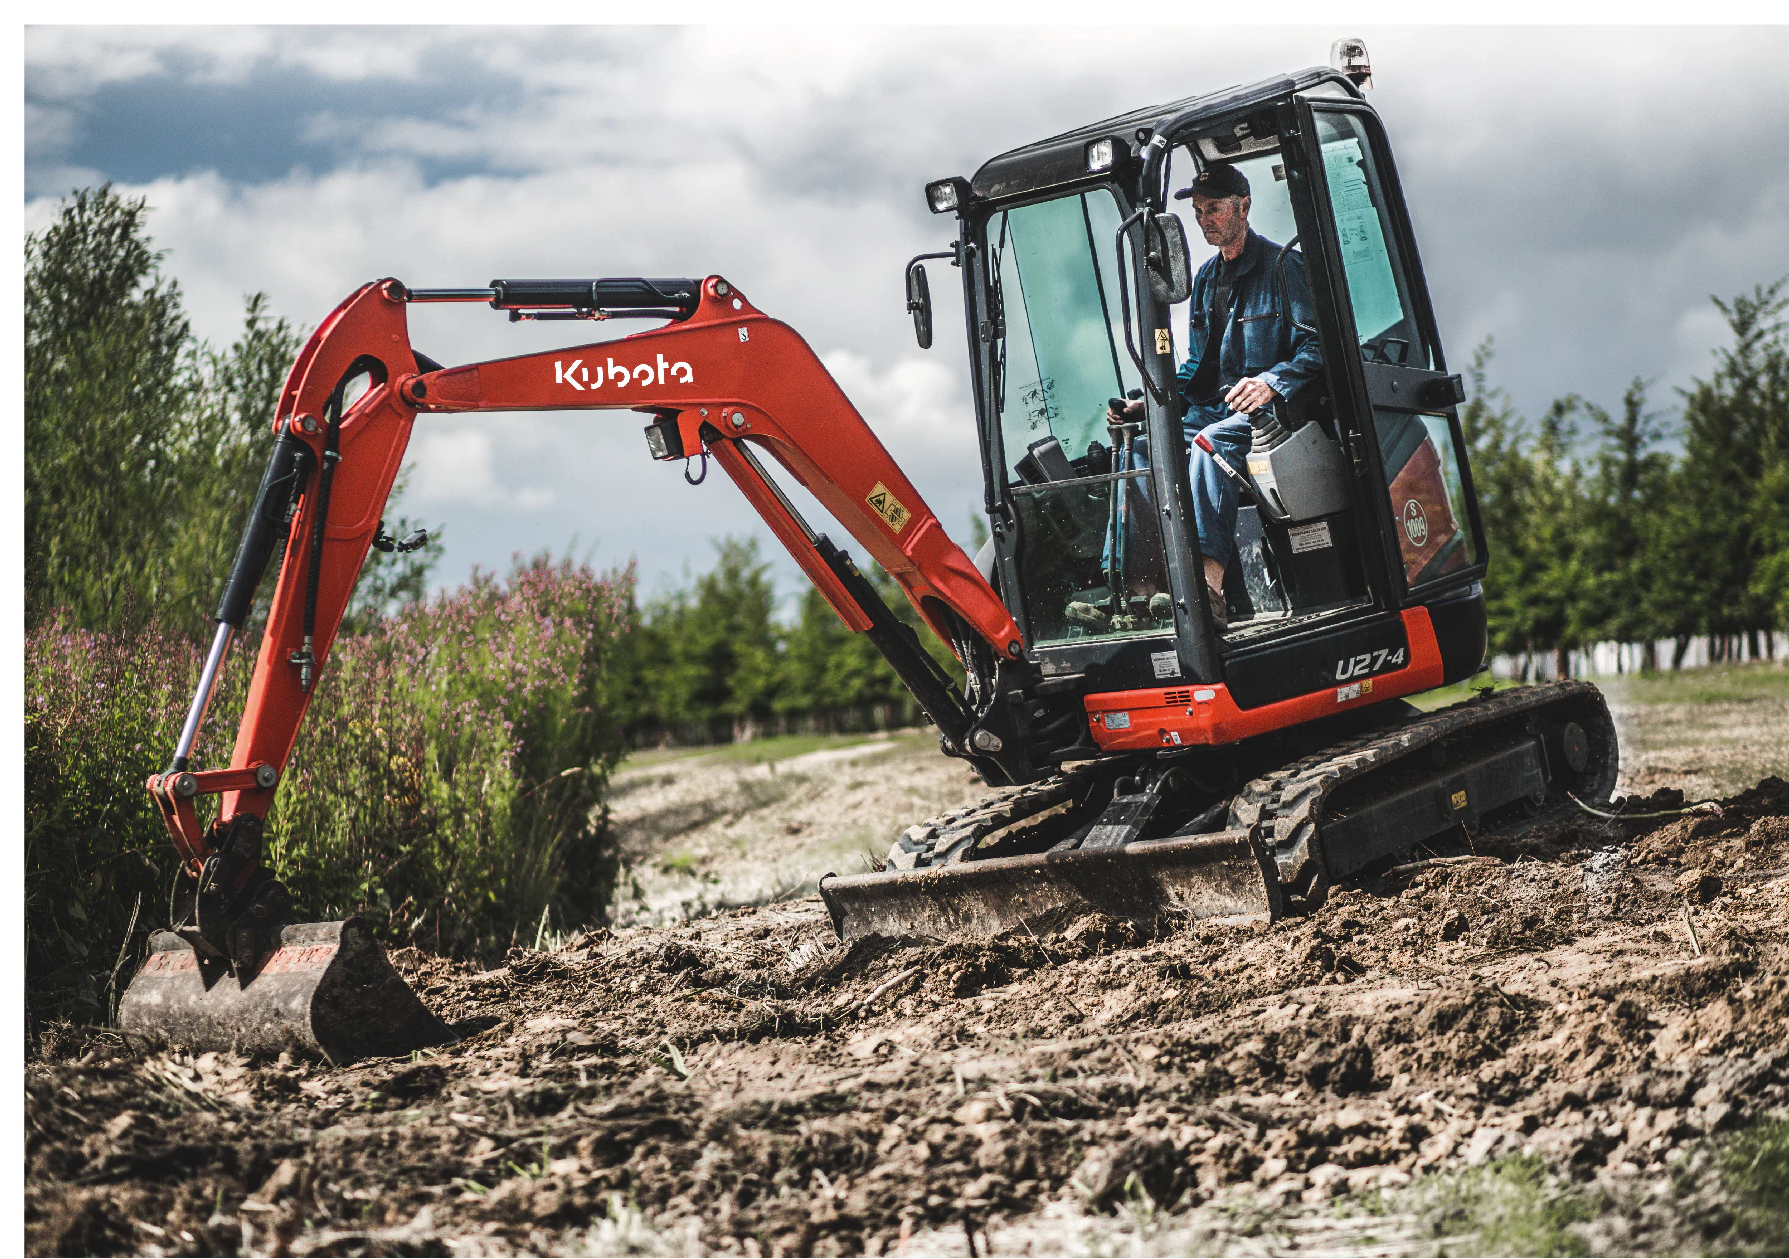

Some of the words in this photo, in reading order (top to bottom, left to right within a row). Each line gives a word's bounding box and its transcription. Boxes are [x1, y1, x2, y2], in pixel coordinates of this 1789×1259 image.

[554, 353, 694, 391] Kubota
[1410, 502, 1417, 516] S
[1406, 516, 1426, 539] 1009
[1335, 647, 1405, 680] U27-4
